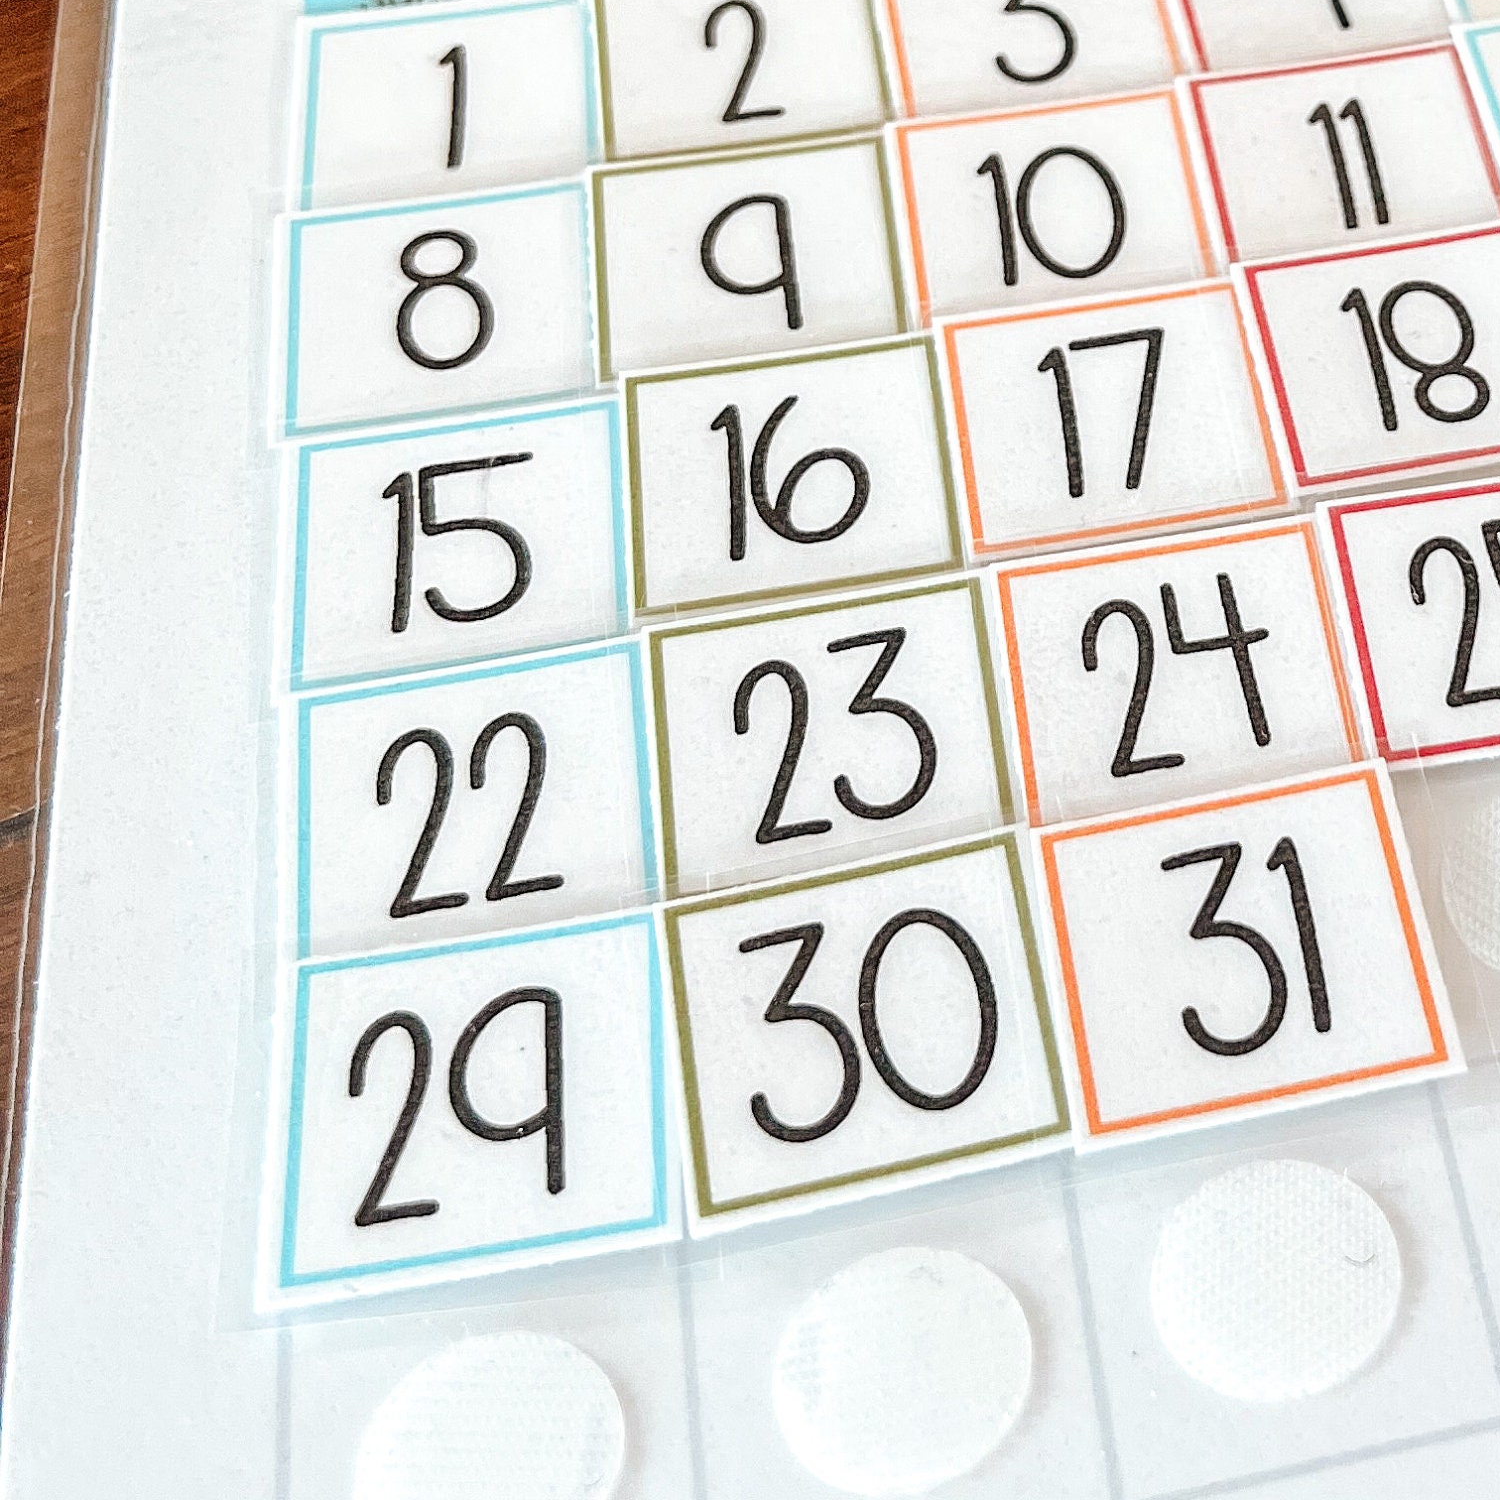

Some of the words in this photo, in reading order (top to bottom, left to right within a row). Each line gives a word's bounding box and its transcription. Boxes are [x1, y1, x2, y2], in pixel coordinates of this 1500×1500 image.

[395, 228, 492, 372] 8
[699, 193, 804, 332] 9
[975, 145, 1127, 288] 10
[1307, 97, 1391, 232] 11
[437, 43, 467, 170] 1
[703, 0, 784, 124] 2
[382, 451, 534, 635] 15
[709, 394, 872, 563] 16
[1036, 326, 1165, 500] 17
[1339, 279, 1493, 434] 18
[375, 710, 565, 920] 22
[732, 626, 938, 846] 23
[1080, 573, 1273, 779] 24
[347, 986, 566, 1230] 29
[737, 908, 999, 1143] 30
[1159, 836, 1333, 1059] 31
